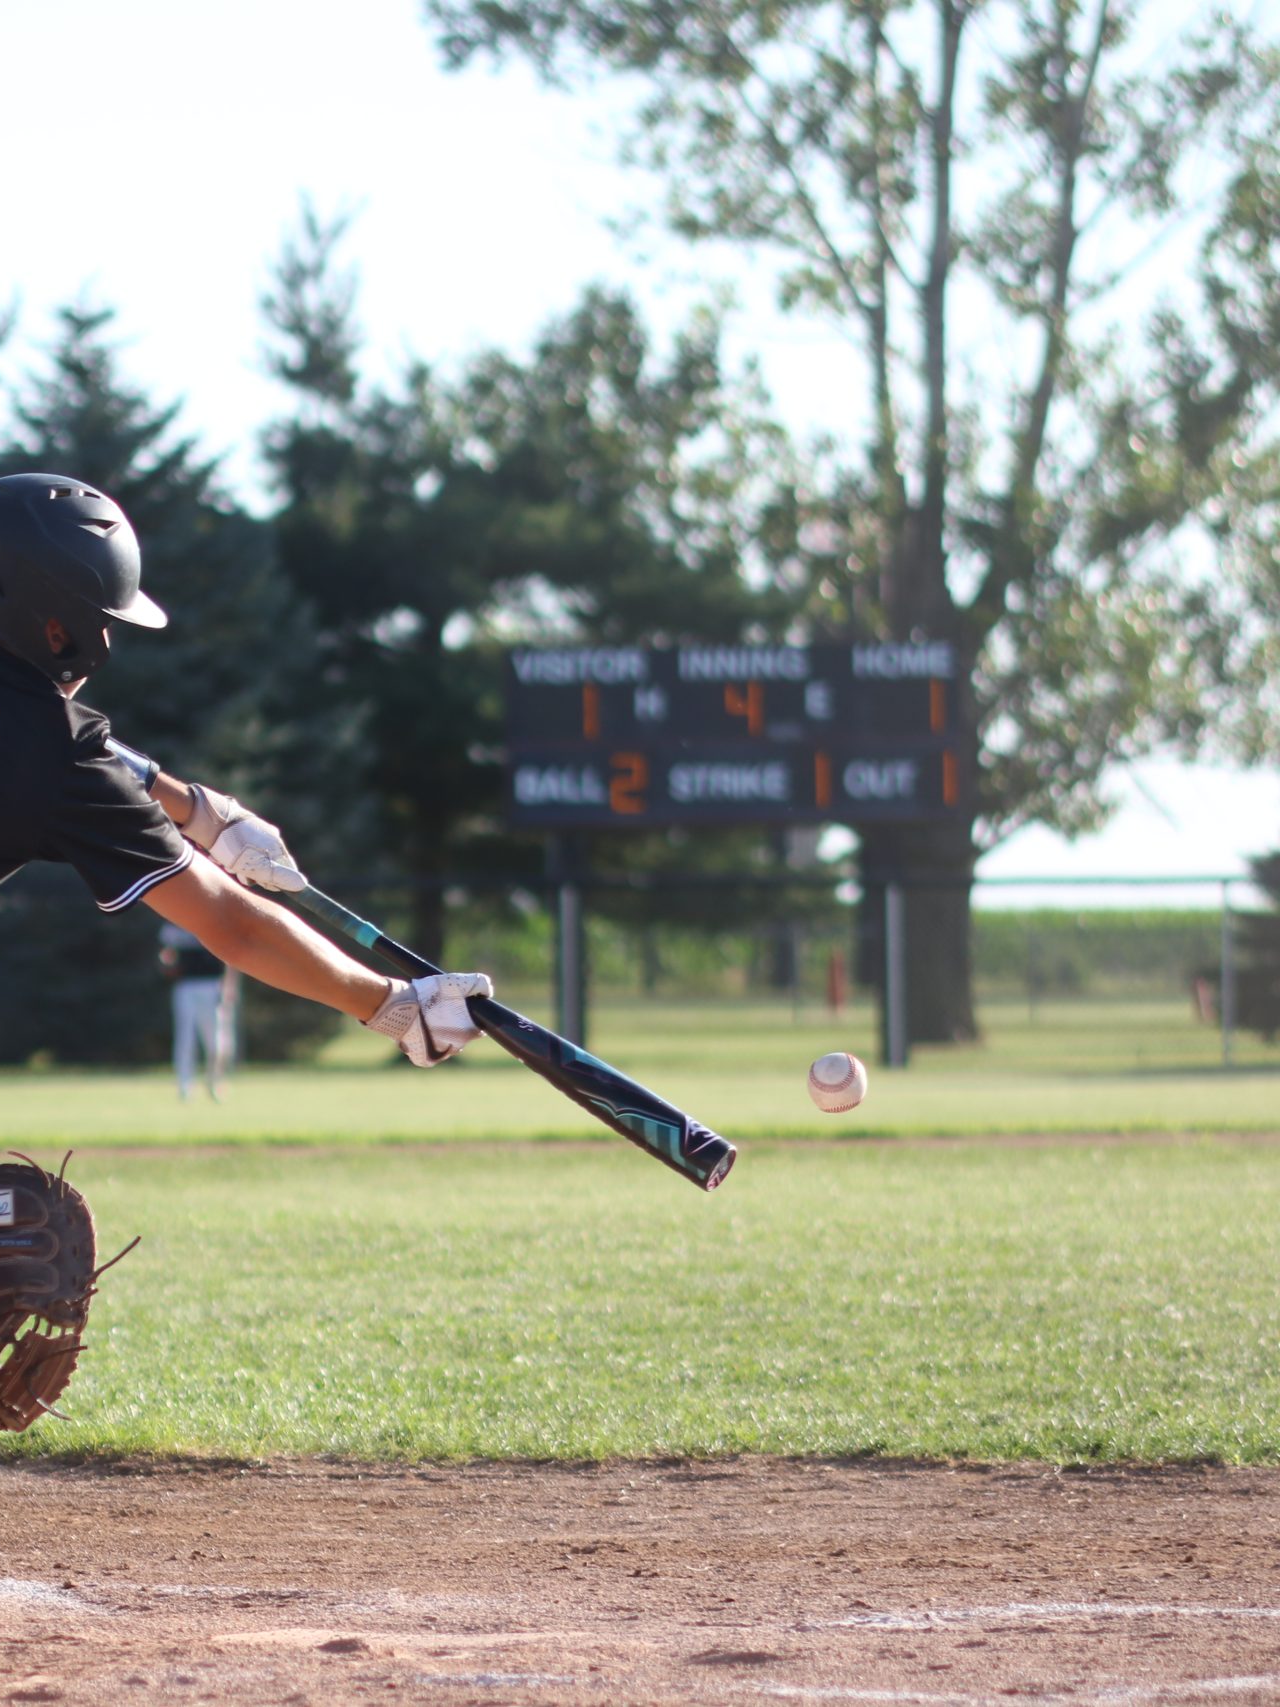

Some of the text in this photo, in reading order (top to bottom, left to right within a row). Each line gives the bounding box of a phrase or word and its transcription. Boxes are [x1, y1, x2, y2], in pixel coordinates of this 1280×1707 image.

[513, 643, 953, 684] VISITOR INNING HOME
[583, 682, 599, 740] 1
[634, 685, 666, 721] H
[725, 680, 762, 737] 4
[931, 678, 946, 734] 1
[514, 749, 958, 814] BALL 2 STRIKE 1 OUT 1
